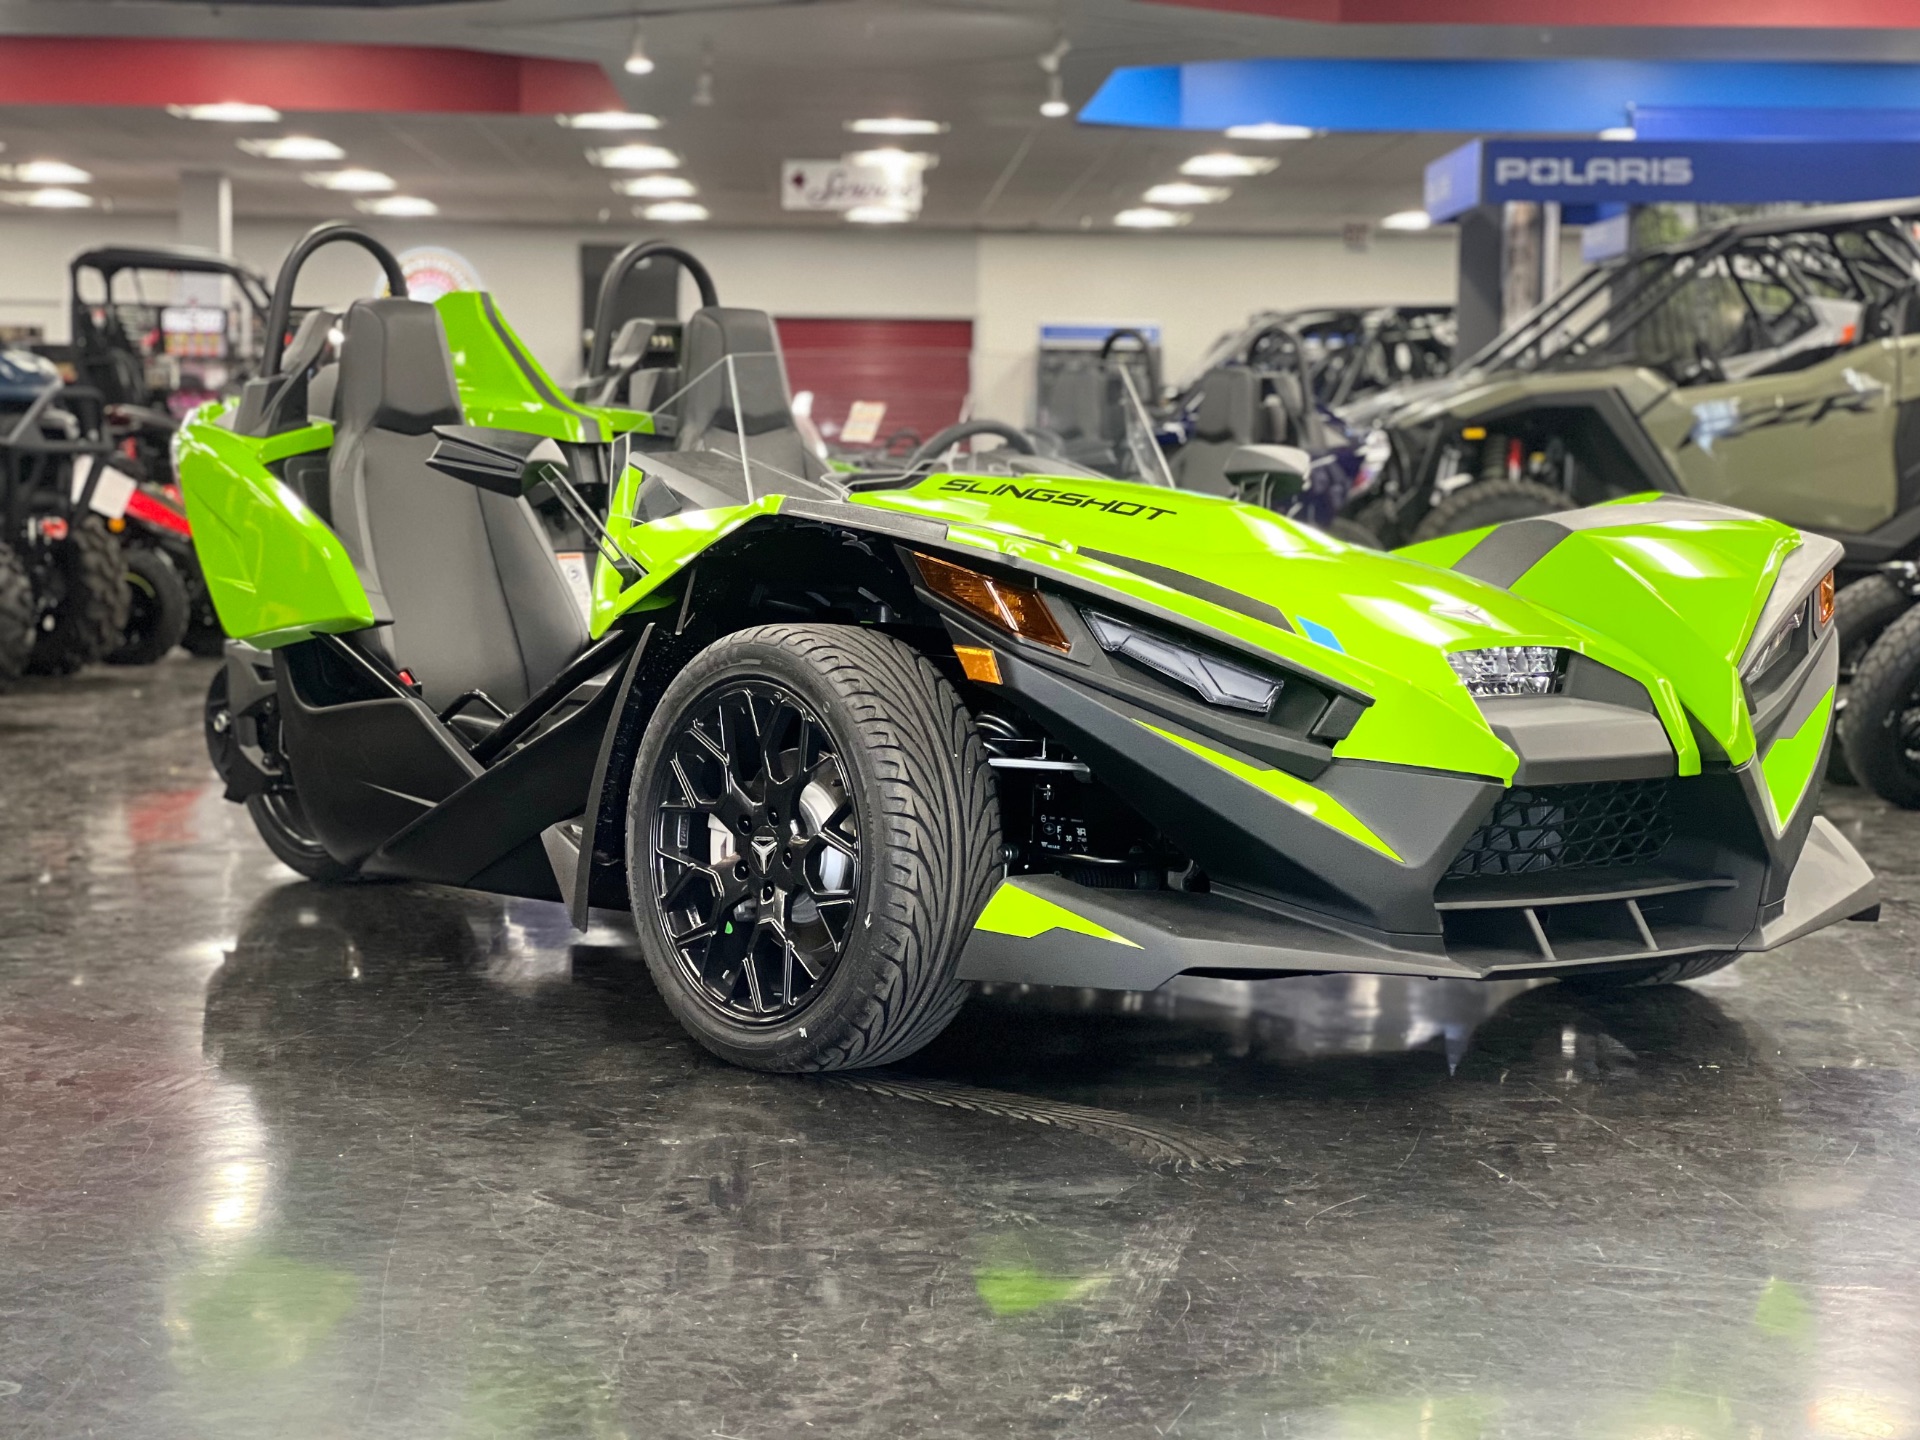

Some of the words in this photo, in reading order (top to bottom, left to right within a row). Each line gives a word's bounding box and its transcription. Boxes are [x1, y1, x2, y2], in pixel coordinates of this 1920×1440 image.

[808, 169, 914, 206] Servie
[1495, 157, 1693, 185] POLARIS
[938, 479, 1177, 520] SLINGSHOT
